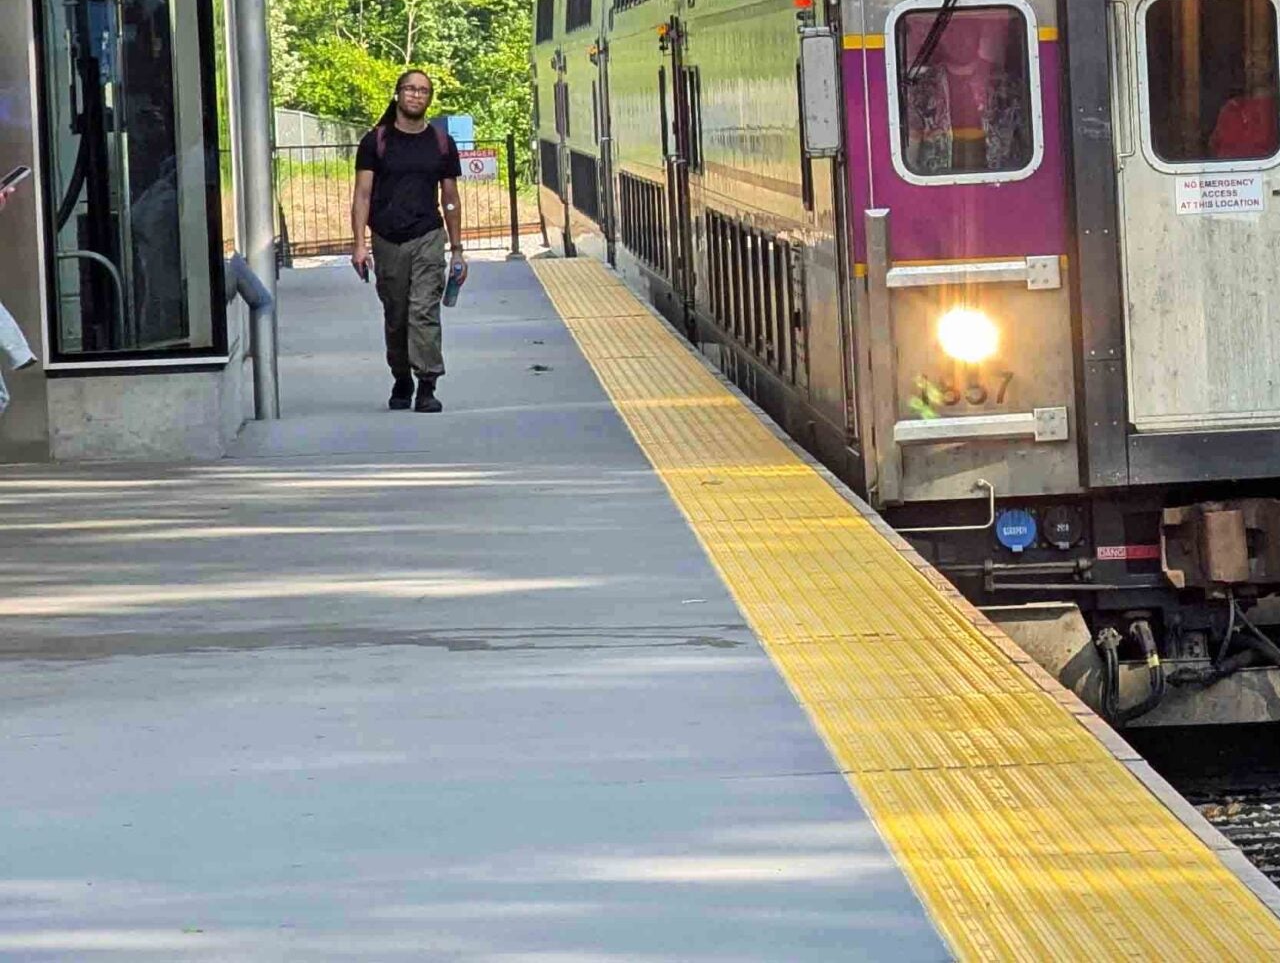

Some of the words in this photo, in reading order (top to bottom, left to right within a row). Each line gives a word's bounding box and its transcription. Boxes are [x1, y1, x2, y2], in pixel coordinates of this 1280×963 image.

[1184, 181, 1198, 189] NO
[1199, 179, 1254, 188] EMERGENCY
[1202, 190, 1238, 198] ACCESS
[1215, 199, 1259, 208] LOCATION
